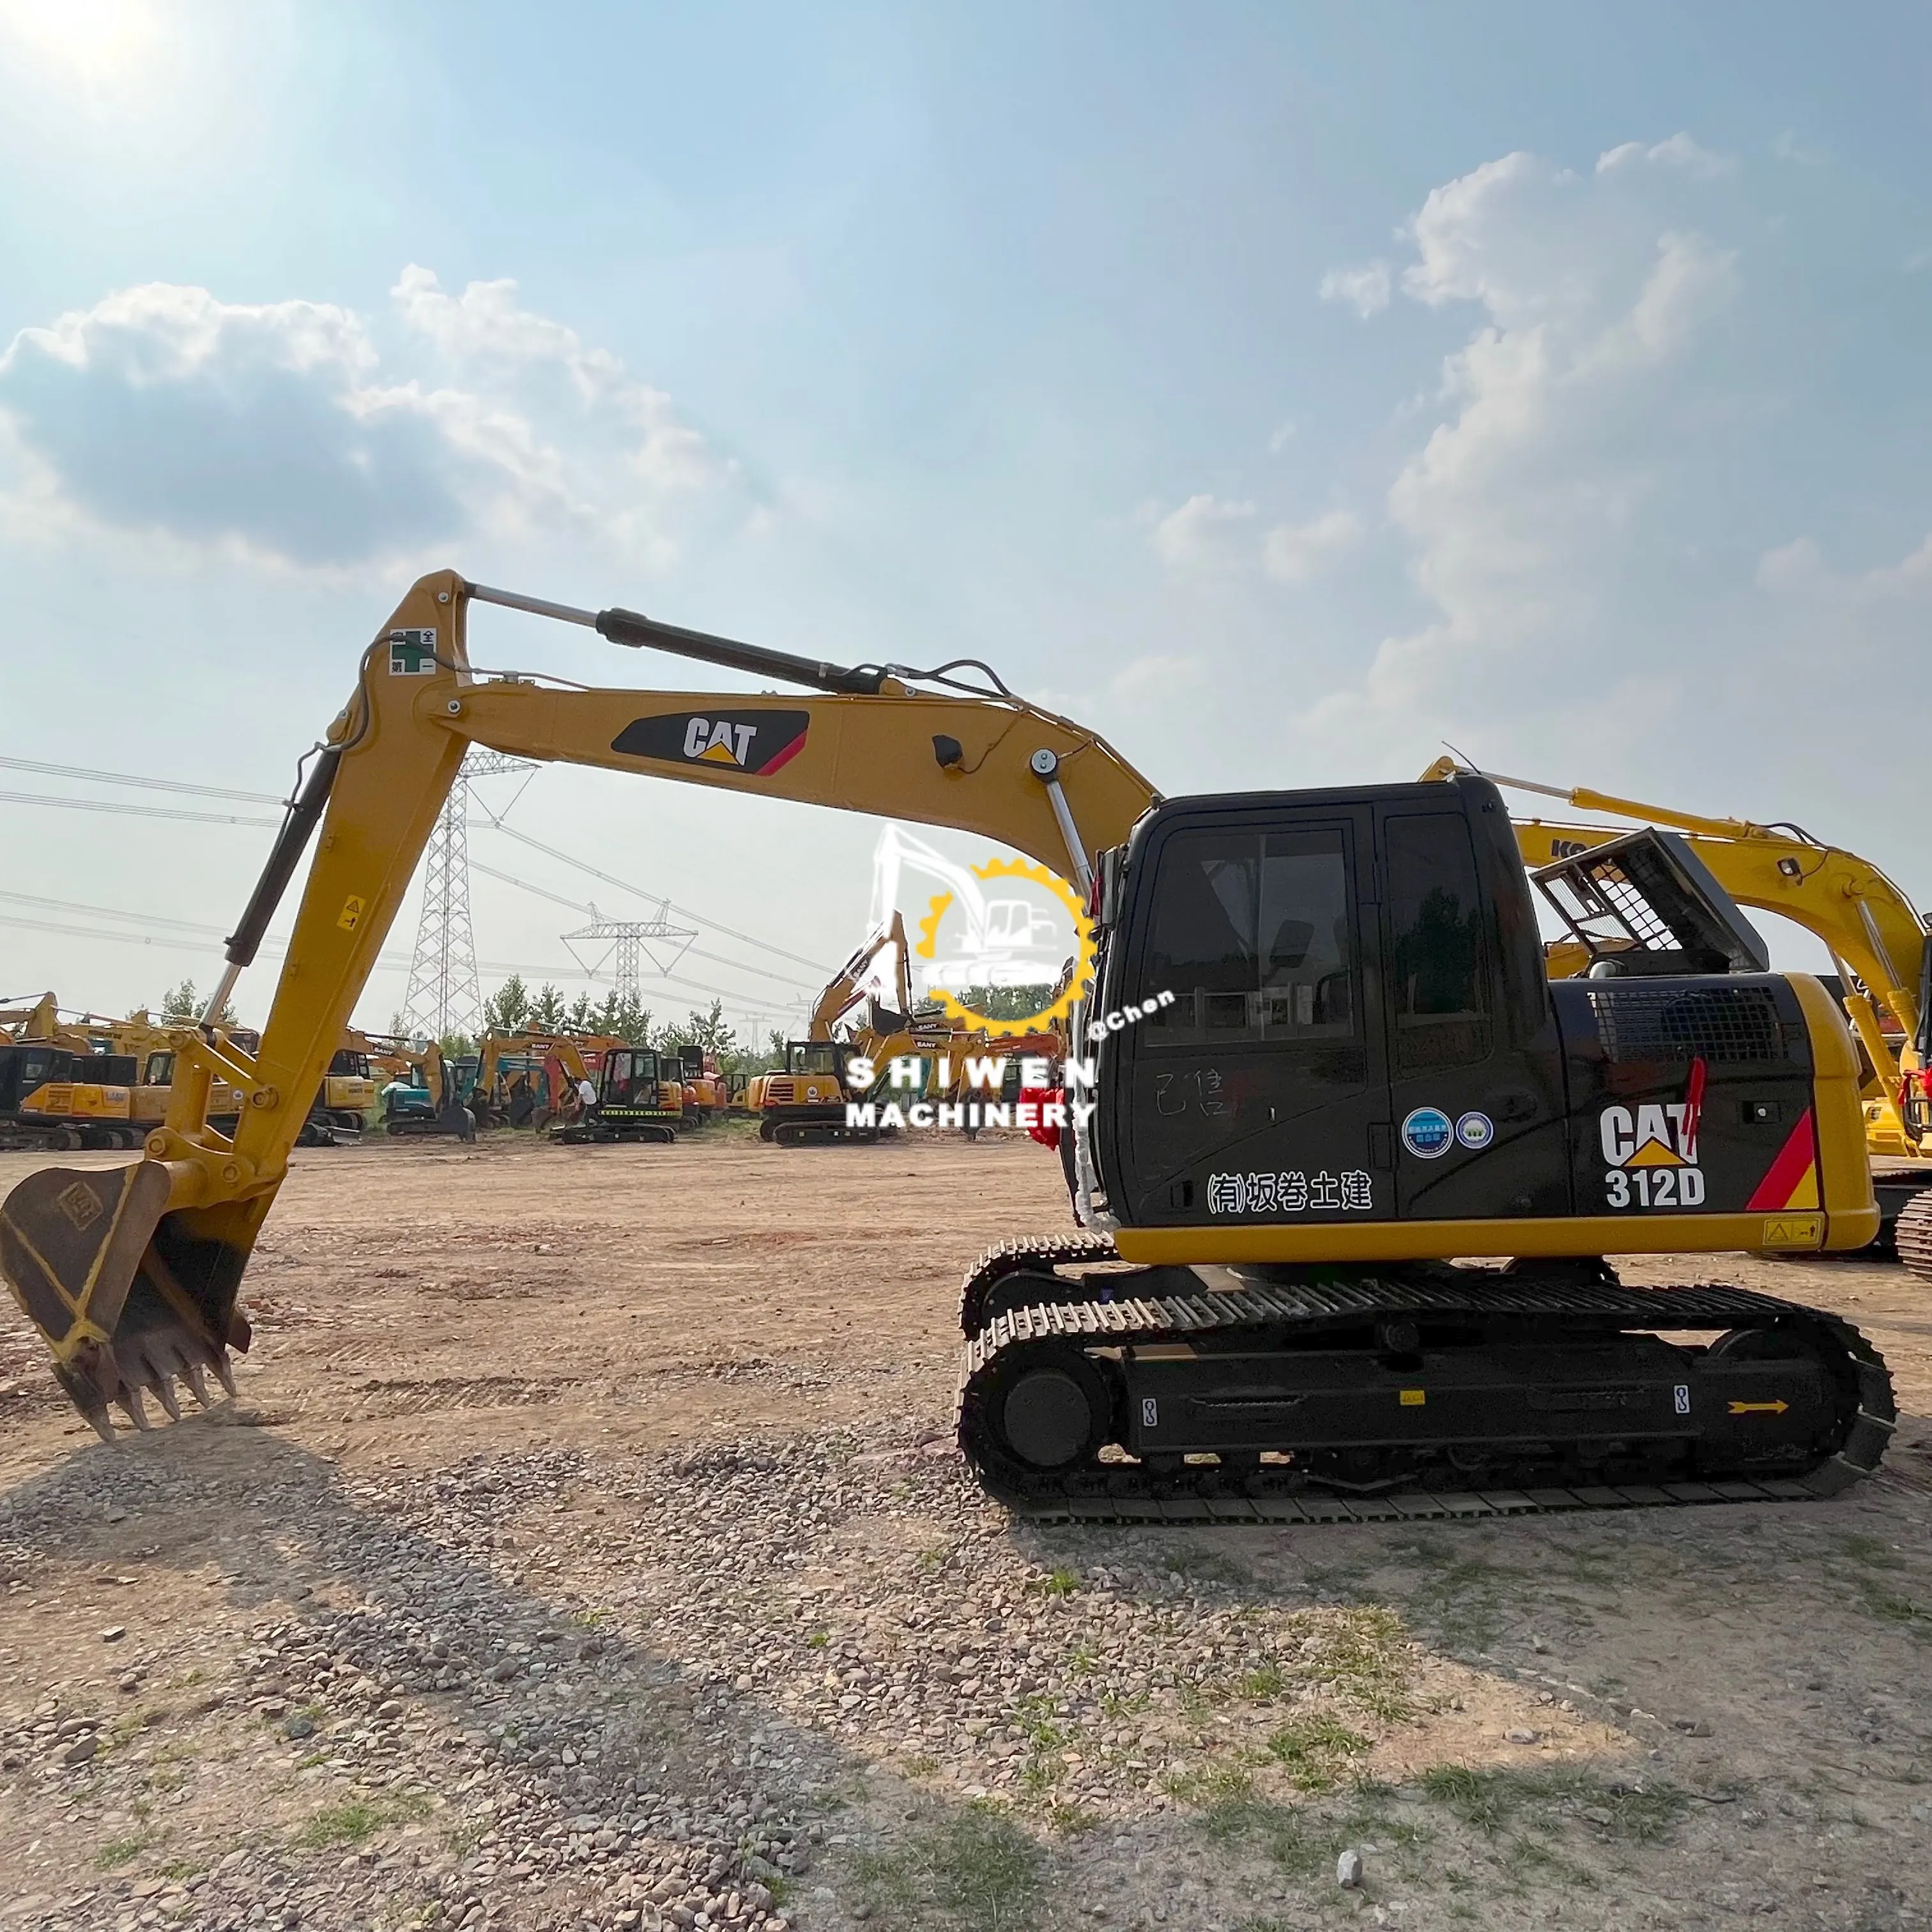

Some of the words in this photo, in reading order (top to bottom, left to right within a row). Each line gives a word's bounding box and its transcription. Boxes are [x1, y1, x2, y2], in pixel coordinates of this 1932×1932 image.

[684, 717, 758, 766] CAT
[1600, 1103, 1701, 1167] CAT
[1605, 1168, 1705, 1208] 312D
